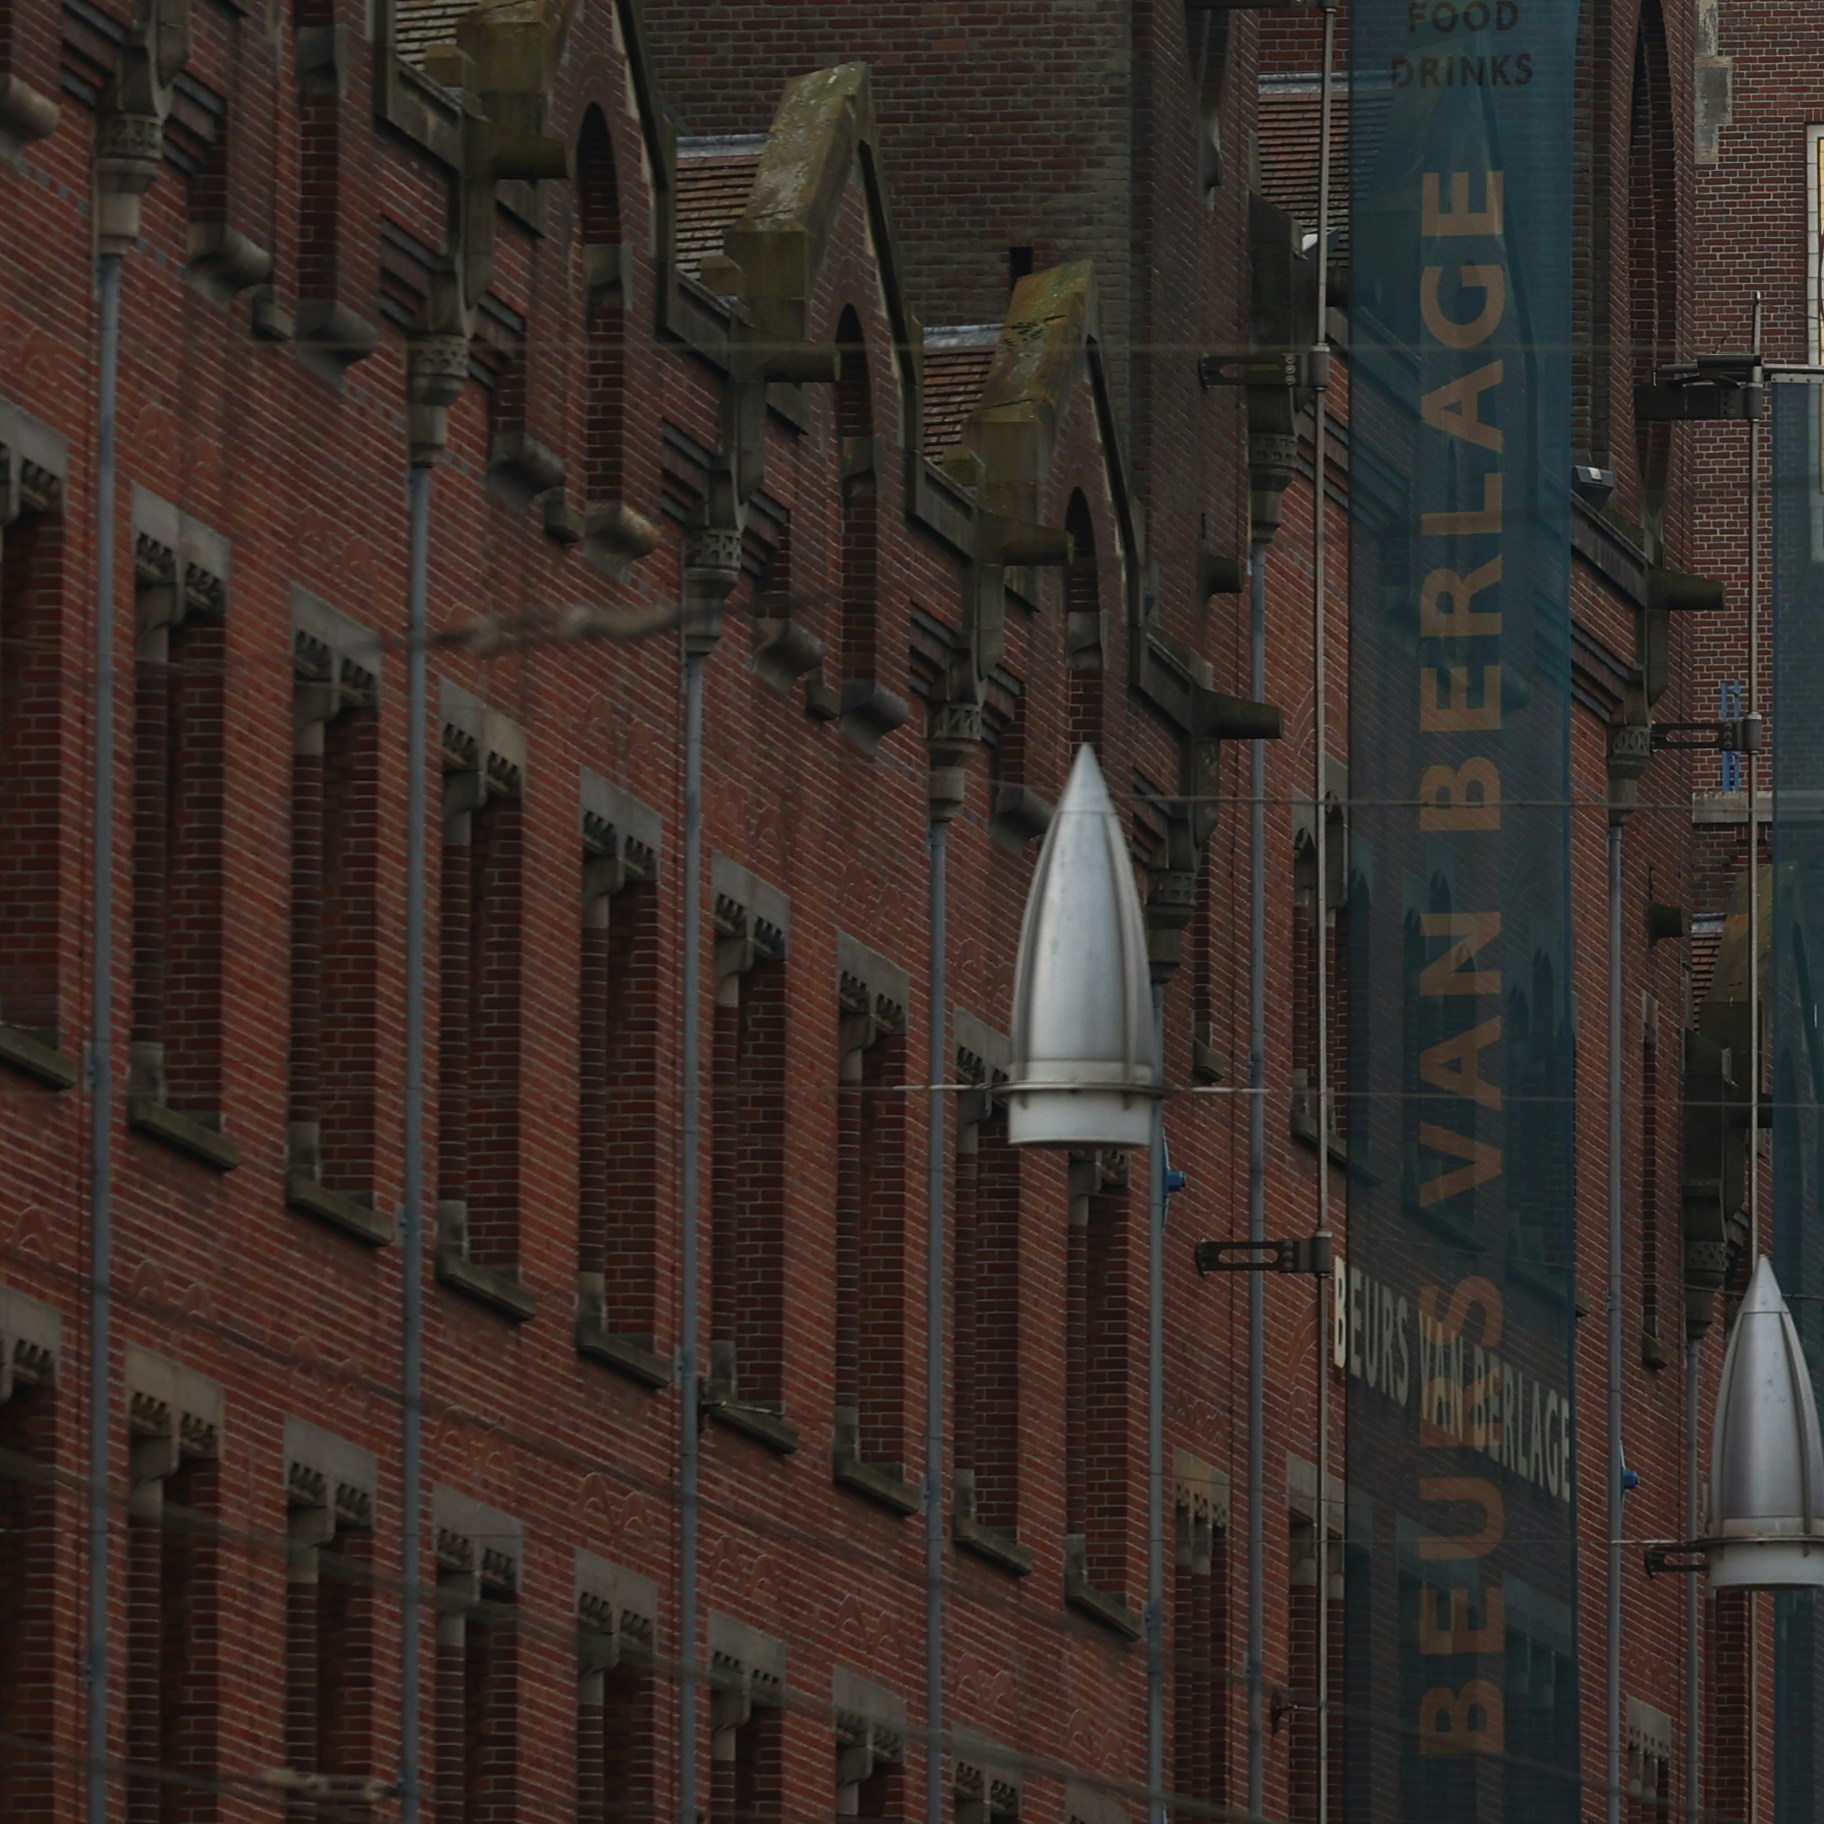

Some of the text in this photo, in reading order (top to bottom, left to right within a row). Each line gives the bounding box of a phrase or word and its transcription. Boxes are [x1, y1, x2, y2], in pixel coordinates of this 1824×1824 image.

[1390, 52, 1534, 88] DRINKS
[1408, 0, 1520, 33] FOOD
[1419, 170, 1506, 1756] BEURS VAN BERLAGE
[1334, 1256, 1570, 1502] BEURS VAN BERLAGE
